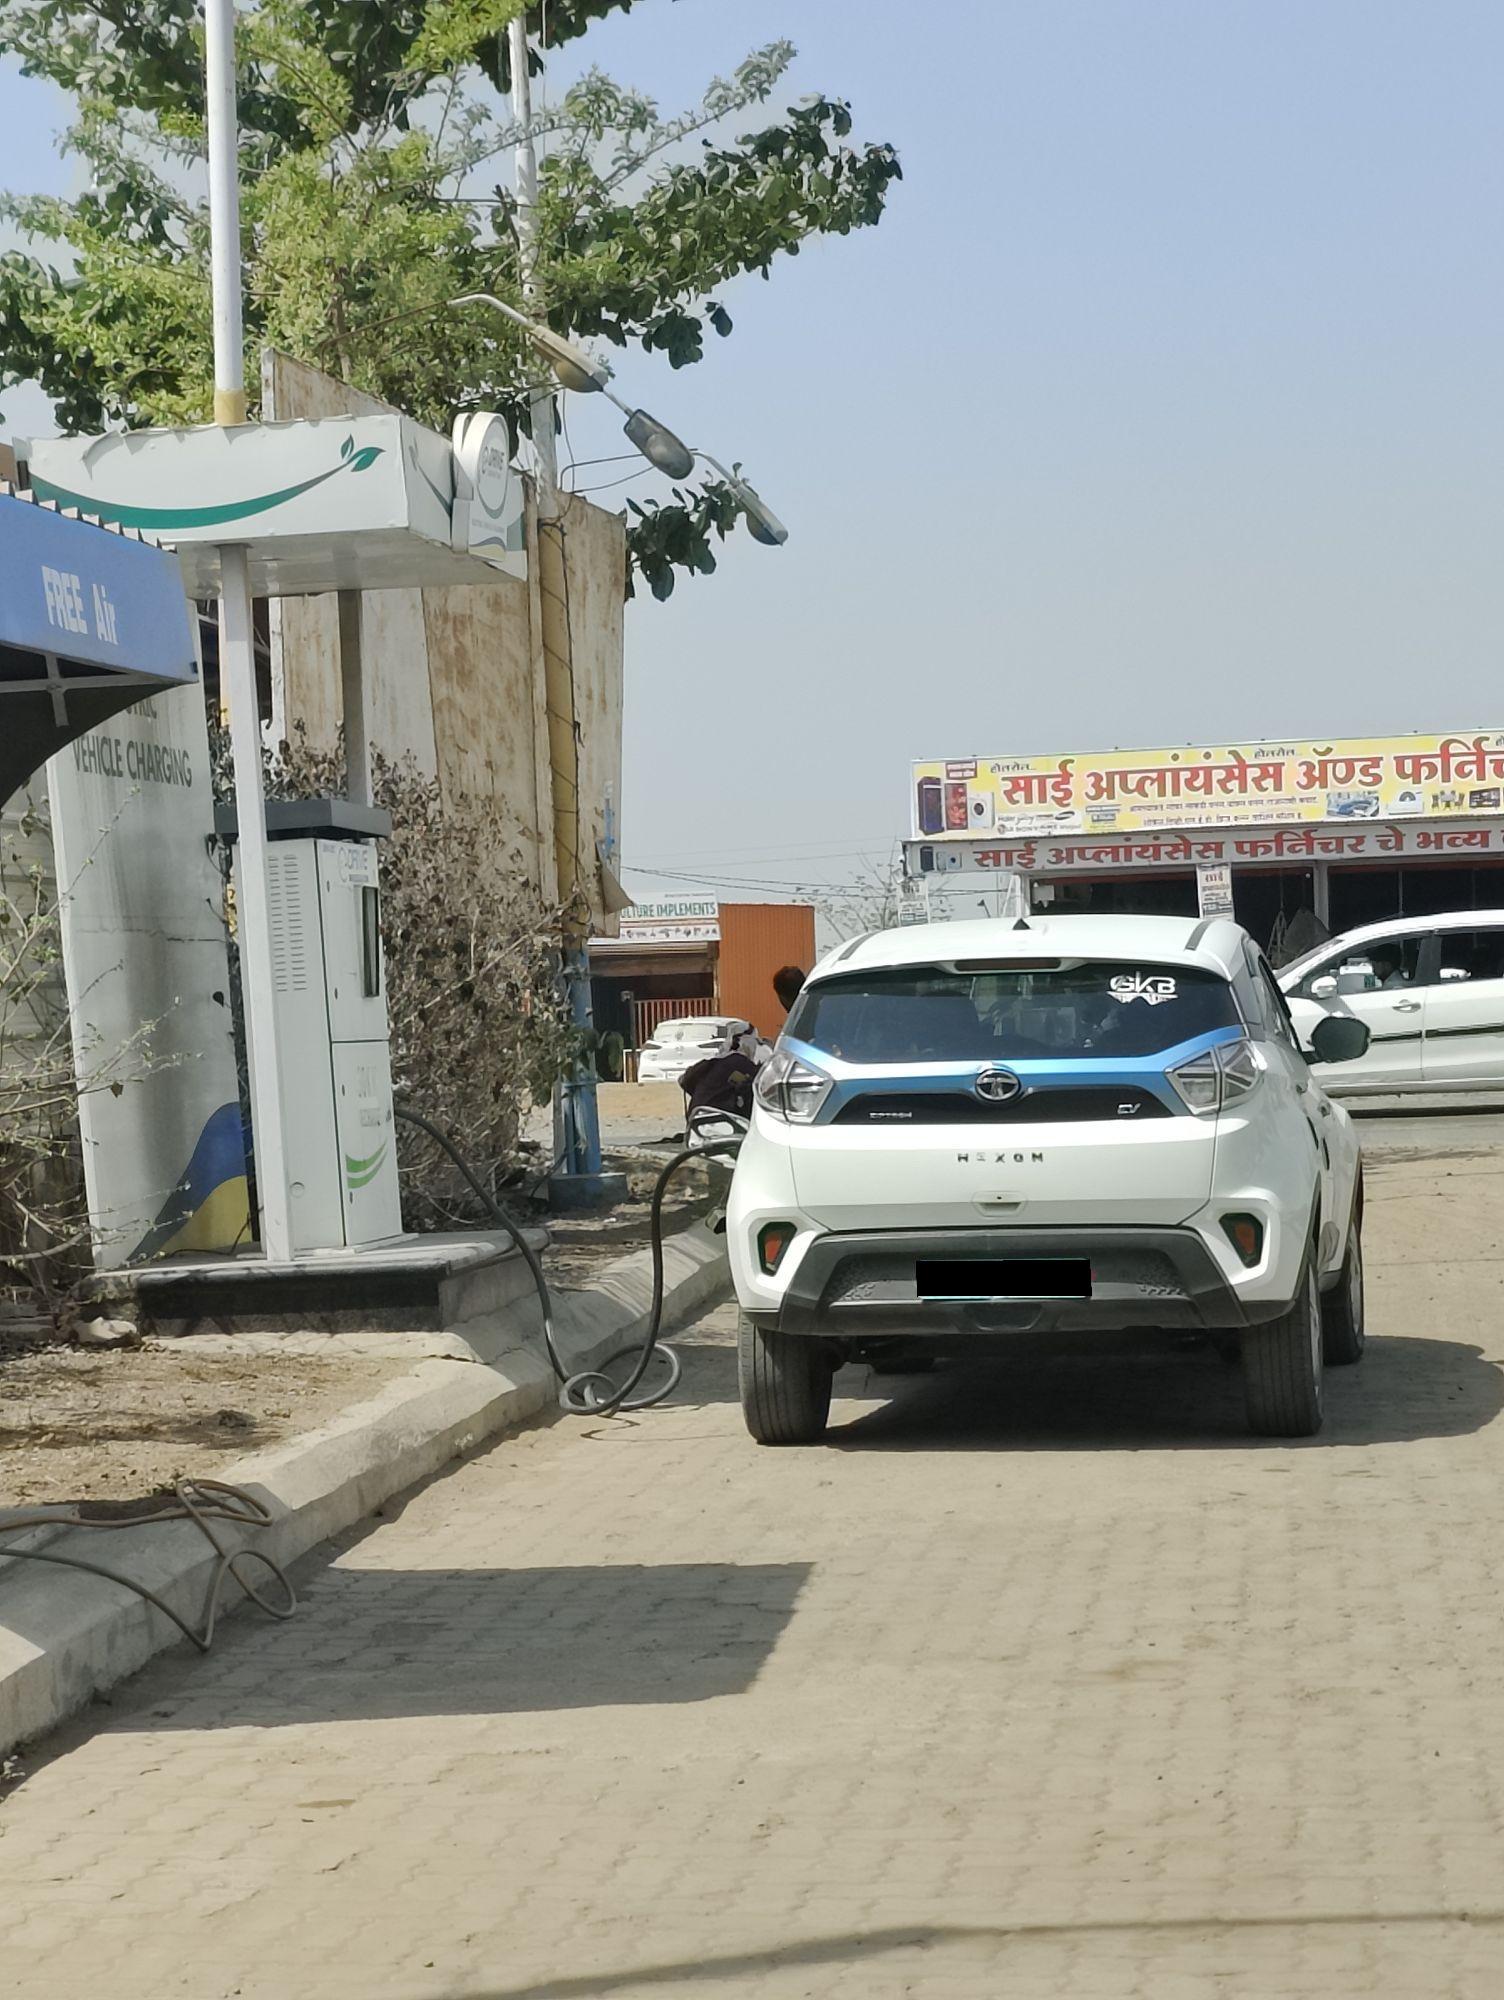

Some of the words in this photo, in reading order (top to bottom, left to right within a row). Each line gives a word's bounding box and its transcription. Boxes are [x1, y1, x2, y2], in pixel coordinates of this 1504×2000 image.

[41, 565, 88, 635] FREE
[92, 583, 119, 645] Air
[72, 734, 124, 779] VEHICLE
[126, 739, 193, 788] CHARGING
[1001, 758, 1075, 808] साई
[972, 840, 1039, 869] साई
[1234, 828, 1367, 859] फर्निचर
[1374, 825, 1407, 851] चे
[1416, 829, 1492, 850] भव्य
[656, 901, 716, 917] IMPLEMENTS
